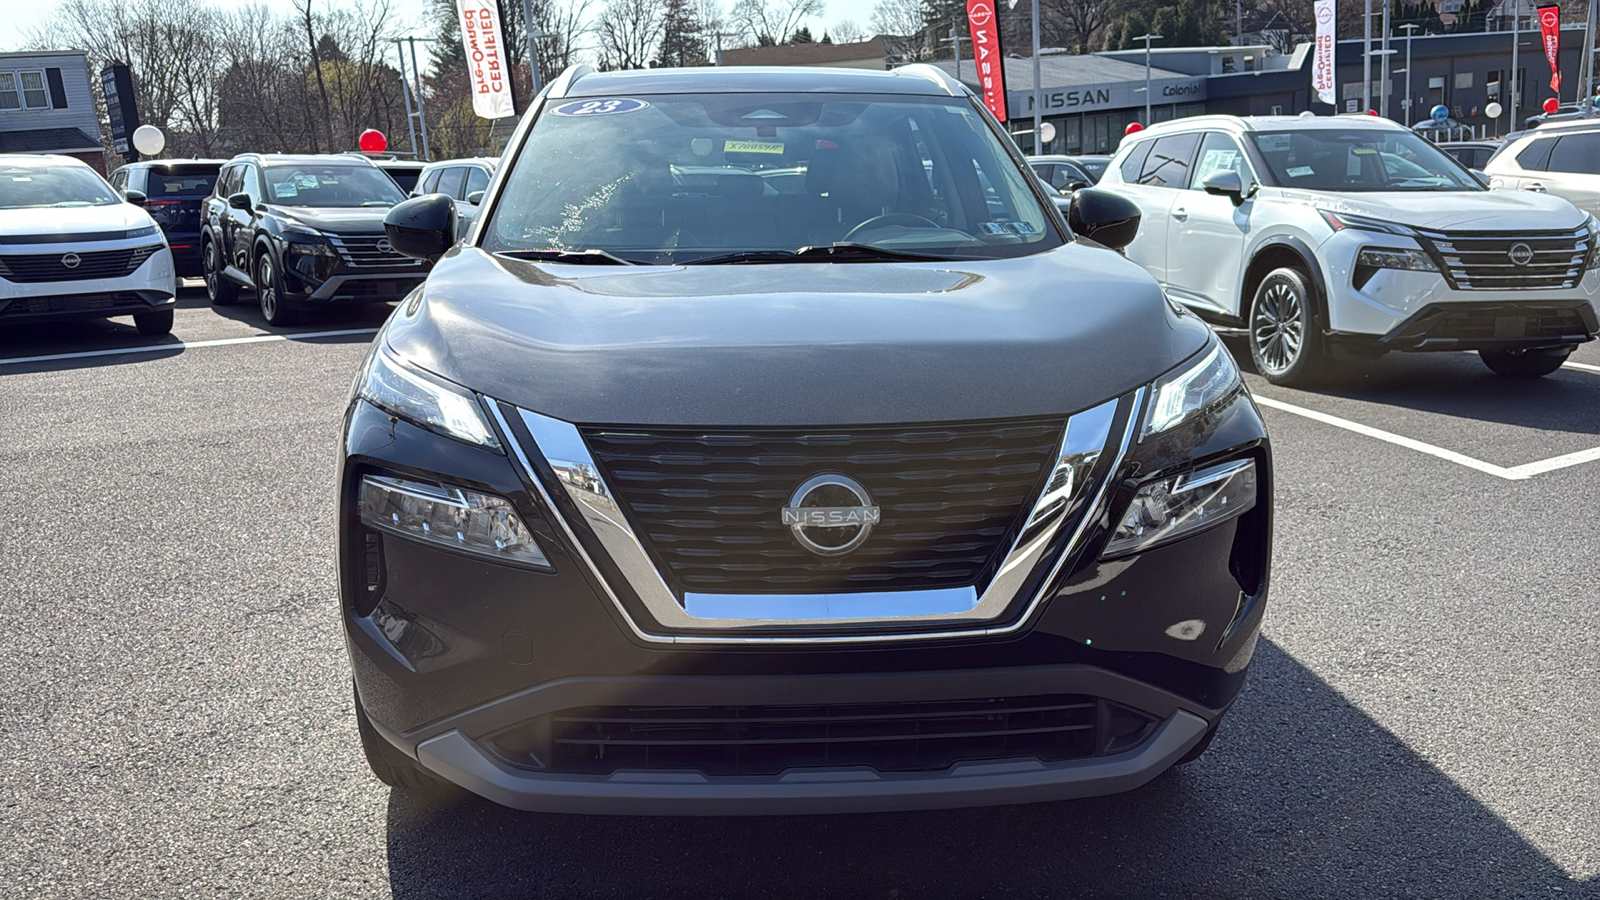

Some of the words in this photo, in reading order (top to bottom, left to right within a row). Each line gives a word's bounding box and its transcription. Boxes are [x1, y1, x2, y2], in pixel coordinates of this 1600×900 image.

[1162, 83, 1200, 96] Colonial
[573, 101, 622, 114] 23
[785, 509, 878, 523] NISSAN
